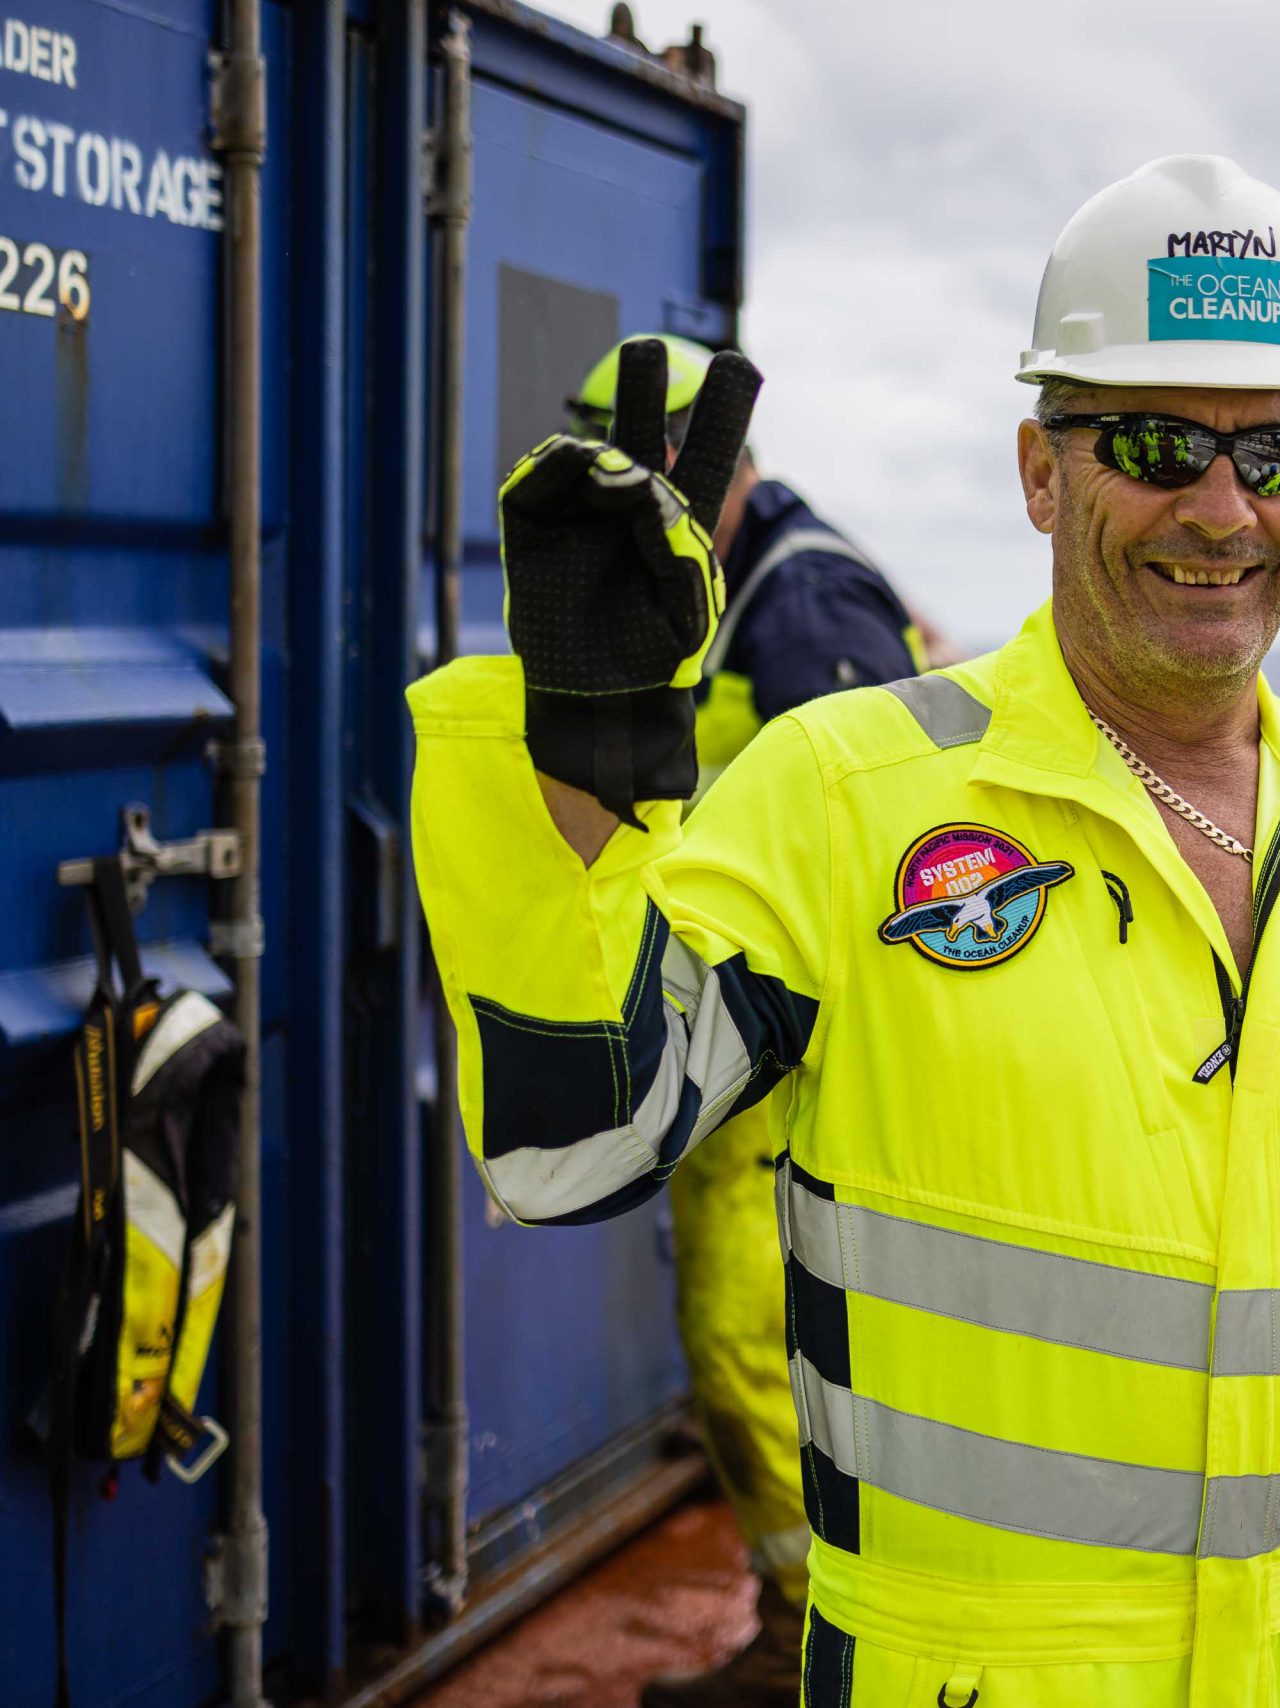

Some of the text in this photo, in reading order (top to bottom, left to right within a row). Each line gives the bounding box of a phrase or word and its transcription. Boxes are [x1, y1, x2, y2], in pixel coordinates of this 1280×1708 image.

[0, 18, 77, 90] DER
[13, 114, 224, 232] STORAGE
[1167, 226, 1277, 260] MARTYN
[1170, 274, 1193, 287] THE
[907, 832, 1015, 888] NORTH PACIFIC MISSION 2021
[920, 847, 997, 887] SYSTEM
[945, 872, 984, 896] 002
[943, 914, 1030, 959] THE OCEAN CLEANUP
[1197, 1049, 1226, 1078] ENGEL
